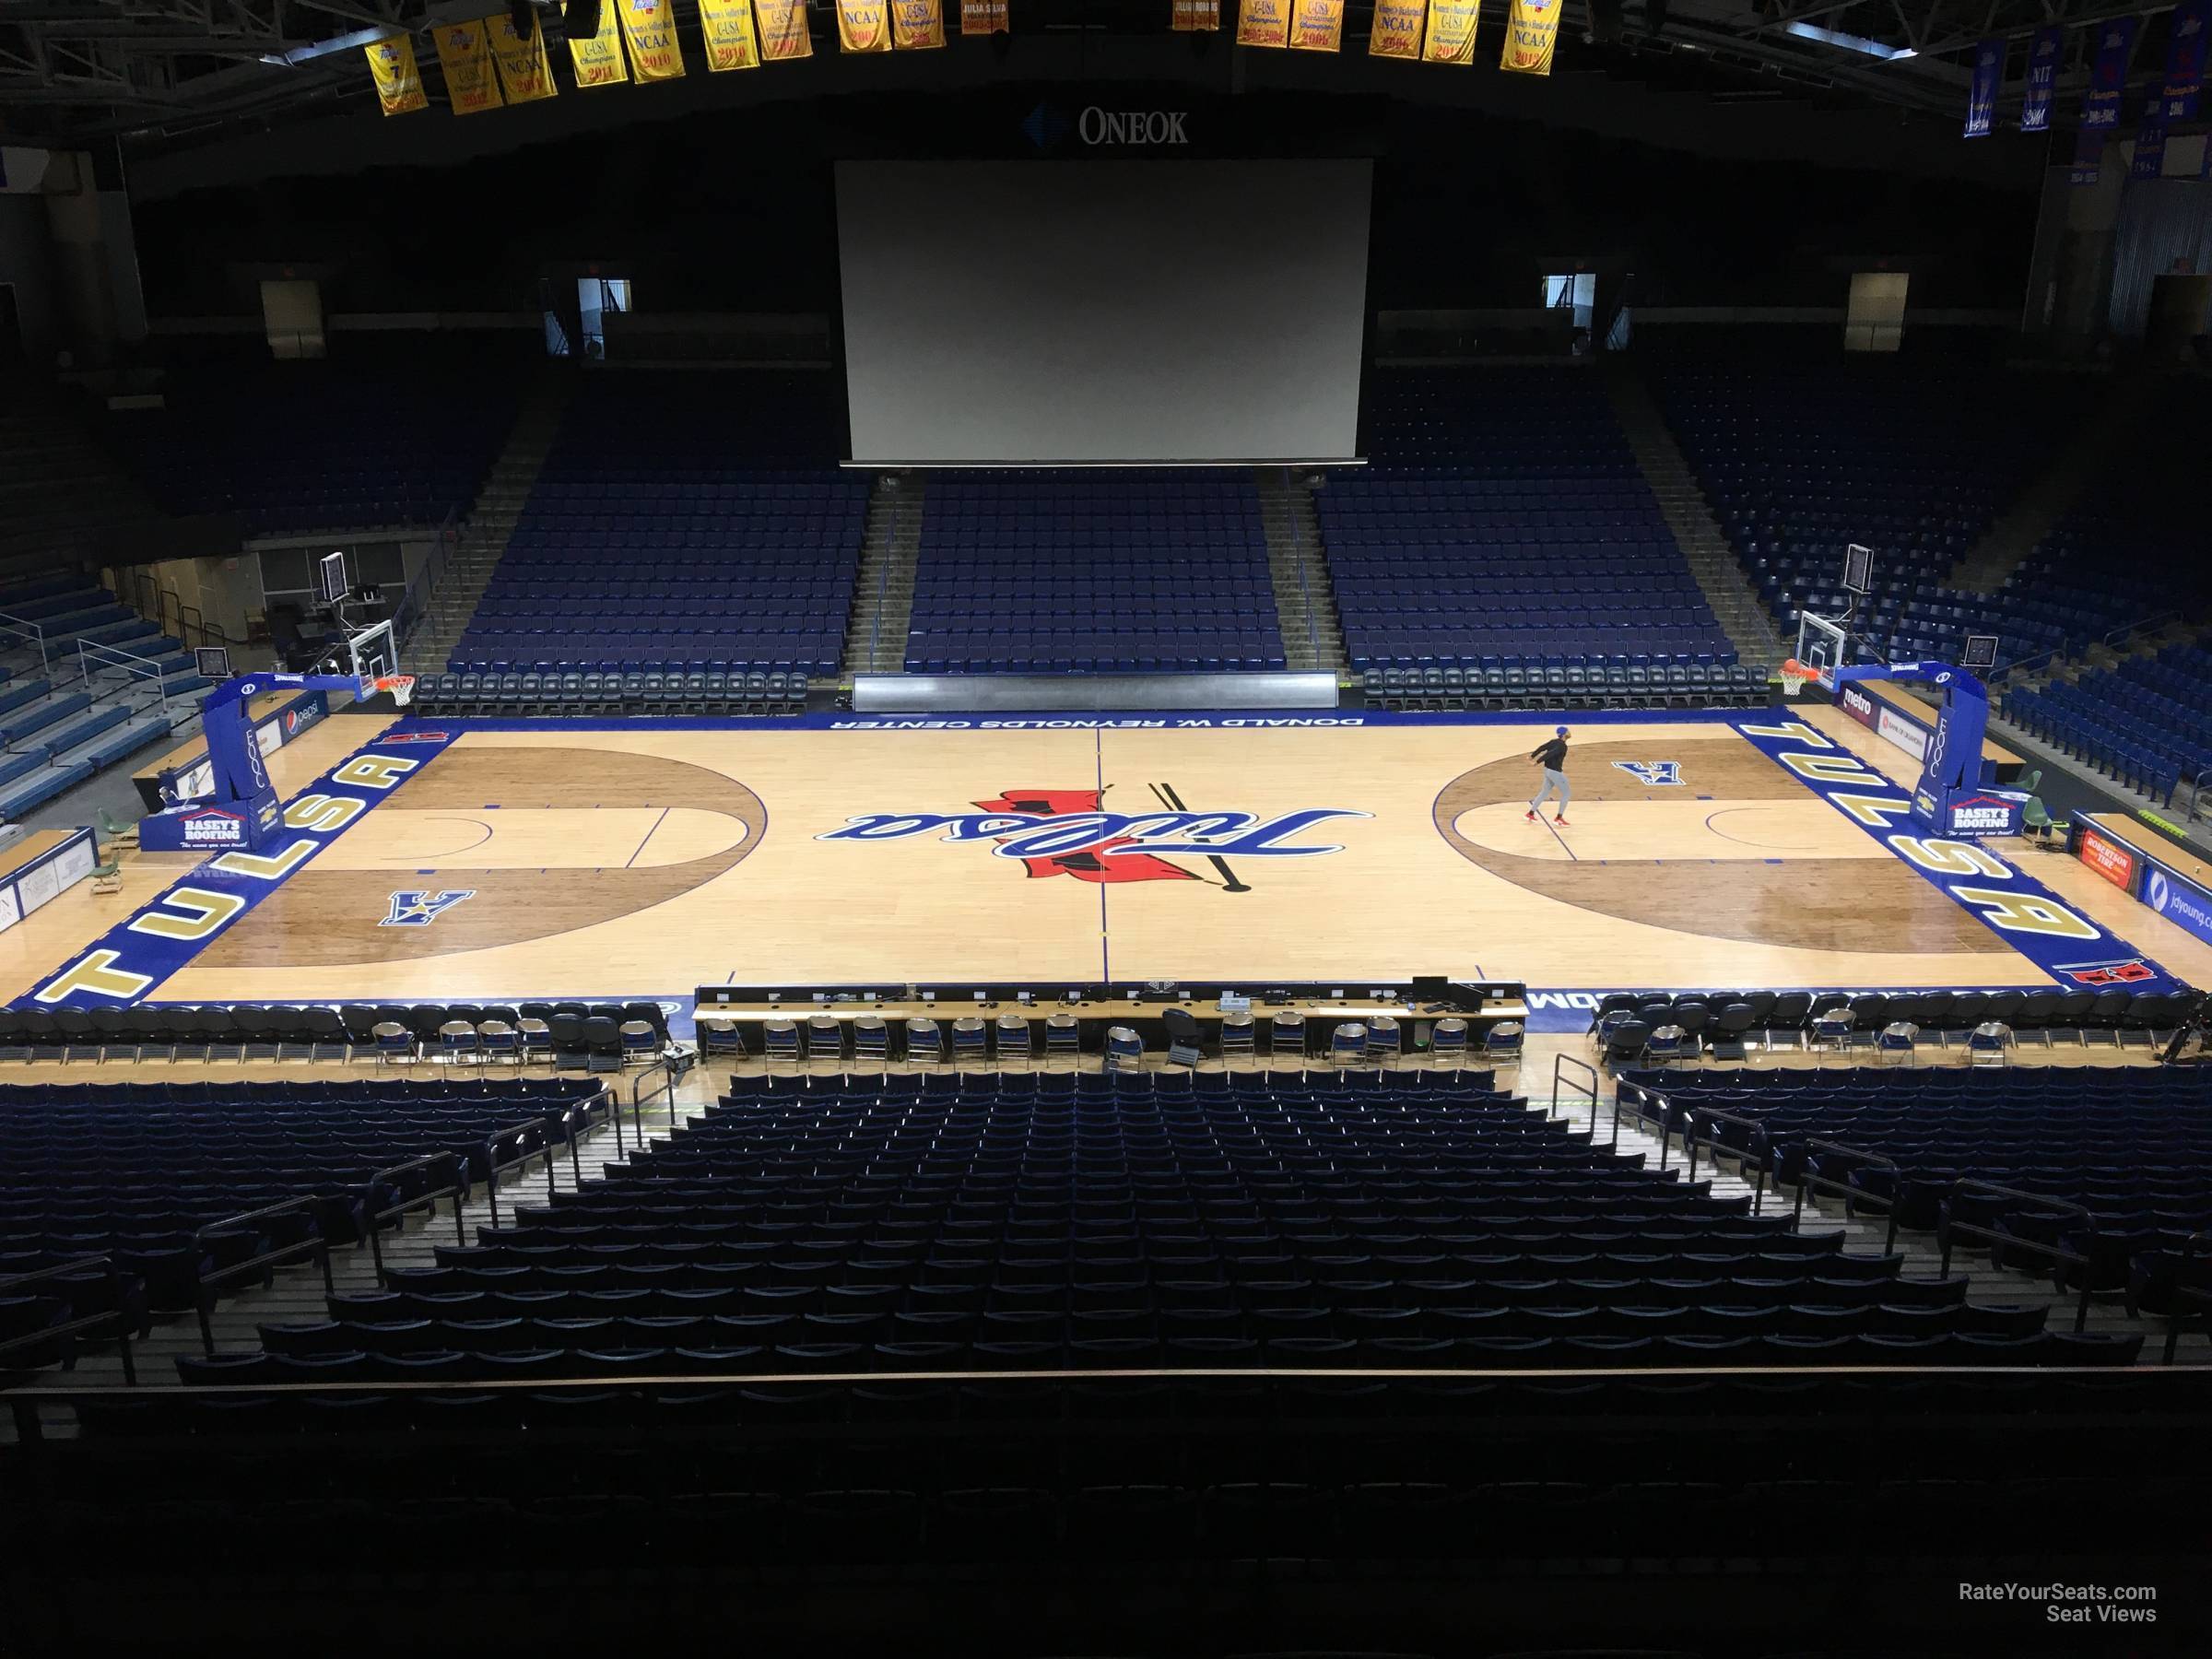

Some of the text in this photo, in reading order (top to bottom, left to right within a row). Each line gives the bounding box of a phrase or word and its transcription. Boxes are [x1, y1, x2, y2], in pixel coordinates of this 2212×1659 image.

[963, 4, 983, 13] JULIA
[845, 10, 880, 25] NCAA
[1381, 16, 1414, 31] NCAA
[1441, 15, 1463, 29] C-USA
[716, 21, 740, 36] C-USA
[635, 33, 670, 50] NCAA
[1513, 29, 1547, 47] NCAA
[506, 58, 542, 75] NCAA
[642, 53, 671, 68] 2010
[588, 65, 613, 81] 2011
[1078, 106, 1189, 145] ONEOK
[1845, 688, 1871, 715] metro
[298, 700, 318, 725] pepsi
[830, 720, 971, 729] CENTER
[979, 719, 1166, 729] REYNOLDS
[1221, 718, 1365, 726] DONALD
[1954, 807, 2010, 818] BASEY'S
[184, 819, 240, 830] BASEY'S
[1738, 721, 2101, 940] TULSA
[1953, 818, 2009, 828] ROOFING
[184, 830, 241, 841] ROOFING
[813, 808, 1376, 858] Tulsa
[2087, 837, 2128, 868] ROBERTSON
[2097, 853, 2115, 869] TIRE
[33, 754, 418, 1003] TULSA
